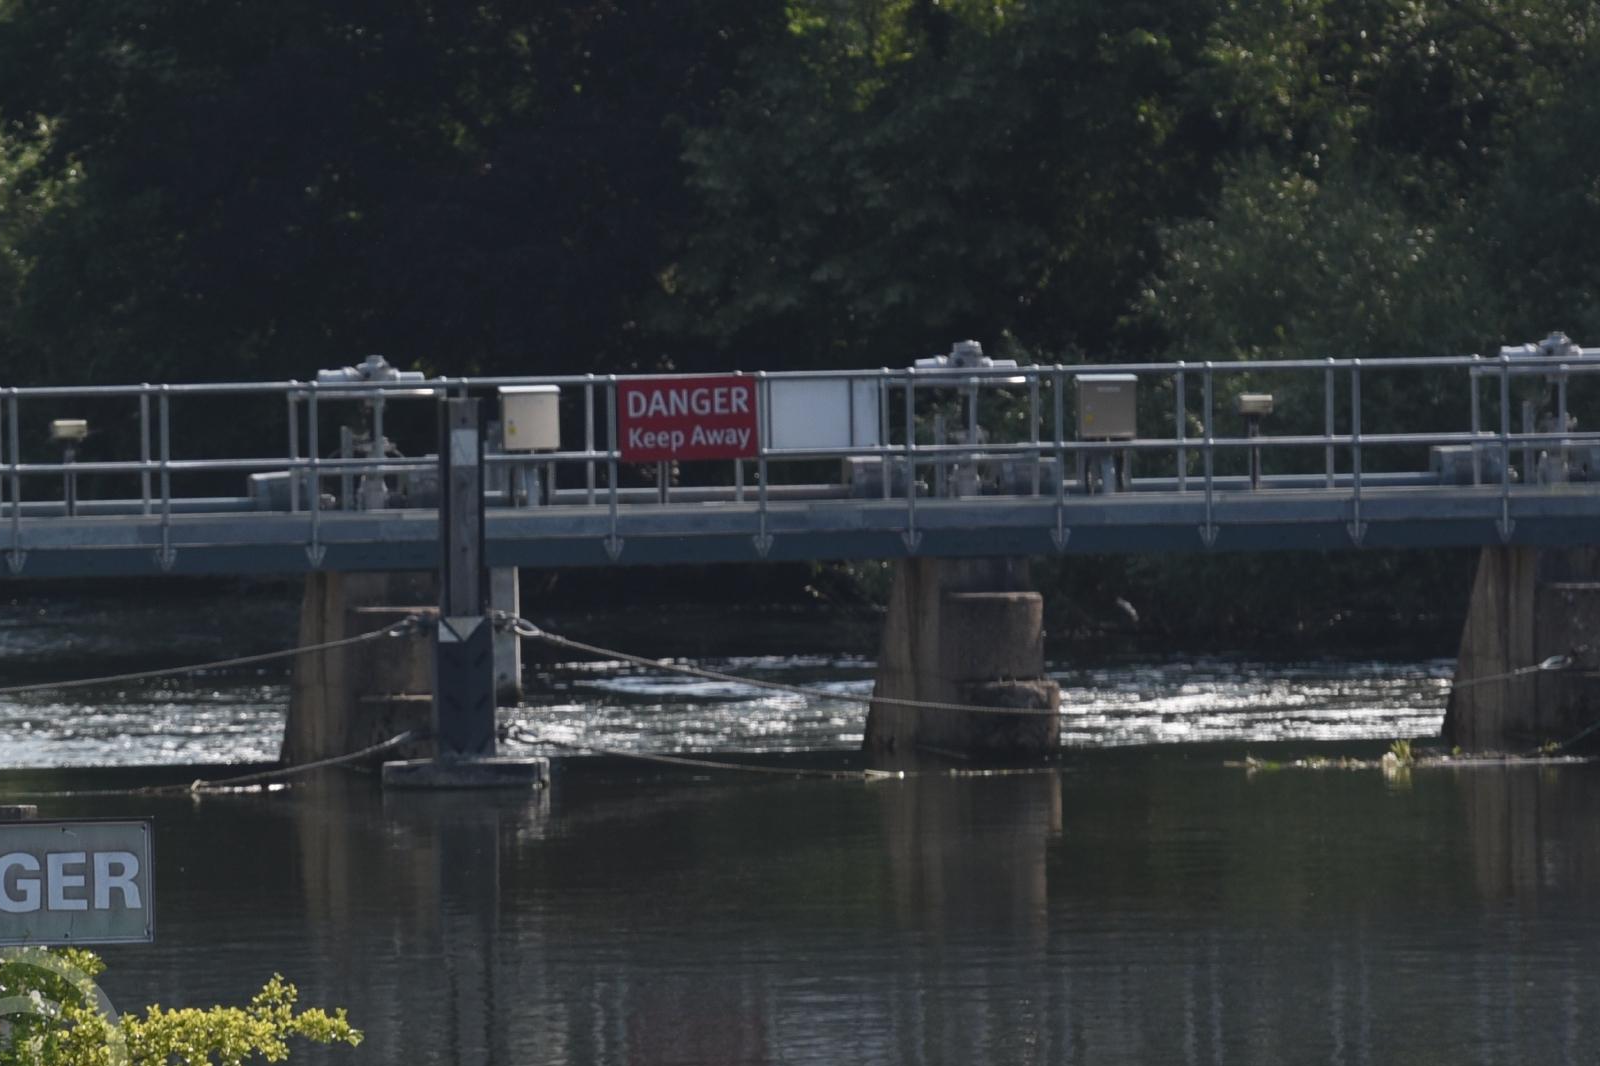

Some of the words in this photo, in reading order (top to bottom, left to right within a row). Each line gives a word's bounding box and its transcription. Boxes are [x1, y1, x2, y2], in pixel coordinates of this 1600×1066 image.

[627, 386, 749, 418] DANGER
[629, 427, 685, 452] Keep
[691, 425, 750, 448] Away
